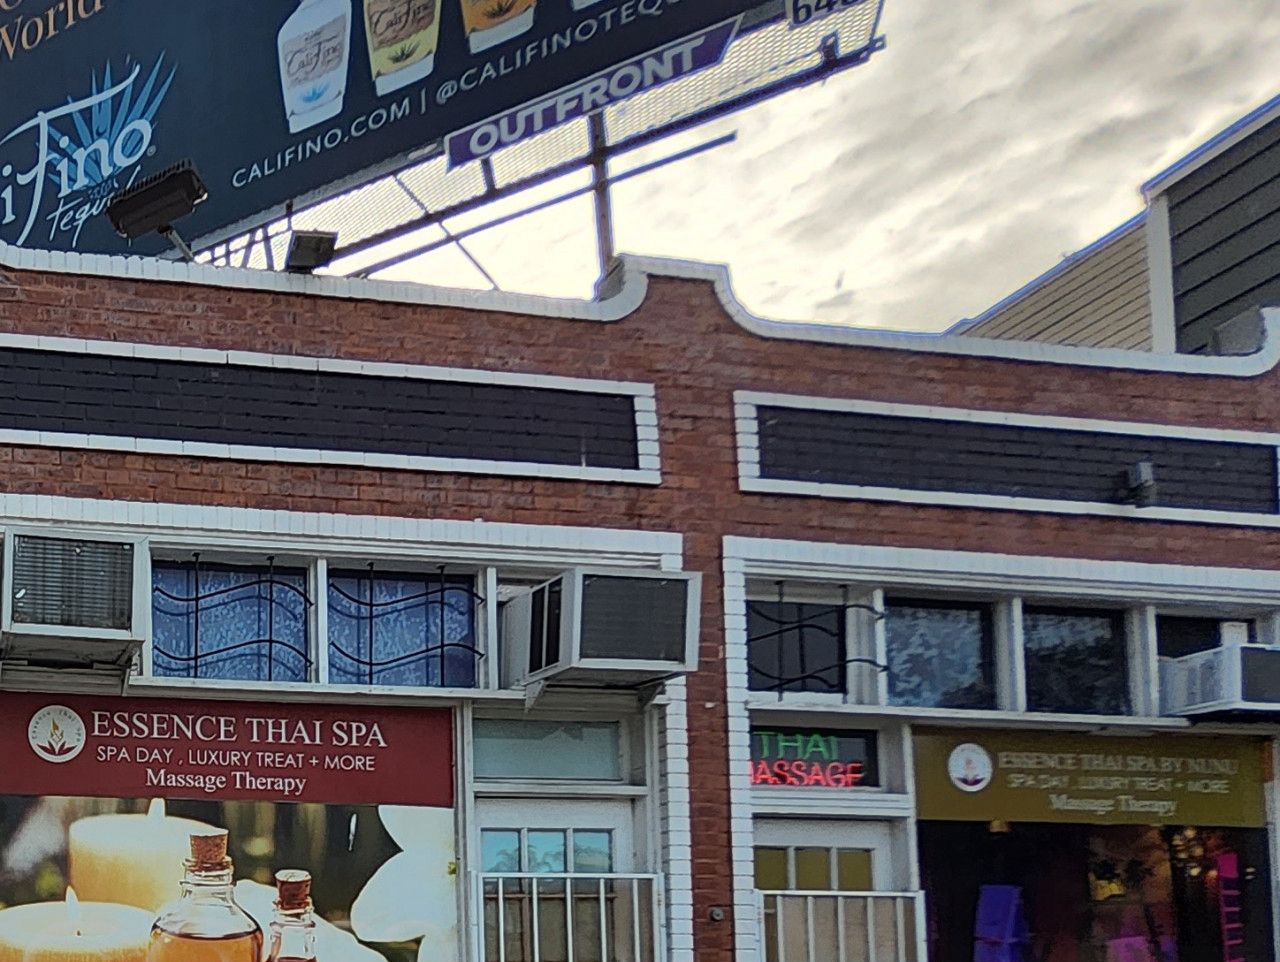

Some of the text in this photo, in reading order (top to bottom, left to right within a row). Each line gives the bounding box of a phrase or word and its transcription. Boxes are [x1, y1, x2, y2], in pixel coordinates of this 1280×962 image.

[231, 97, 410, 188] CALIFINO.COM
[436, 0, 682, 105] @CALIFINOTEQ
[470, 36, 706, 156] OUTFRONT
[92, 712, 387, 746] ESSENCE THAI SPA
[97, 746, 130, 761] SPA
[137, 748, 173, 763] DAY
[189, 750, 251, 766] LUXURY
[256, 752, 304, 767] TREAT
[325, 755, 374, 770] MORE
[752, 731, 838, 760] THAI
[146, 769, 306, 795] Massage Therapy
[748, 760, 864, 786] ASSAGE
